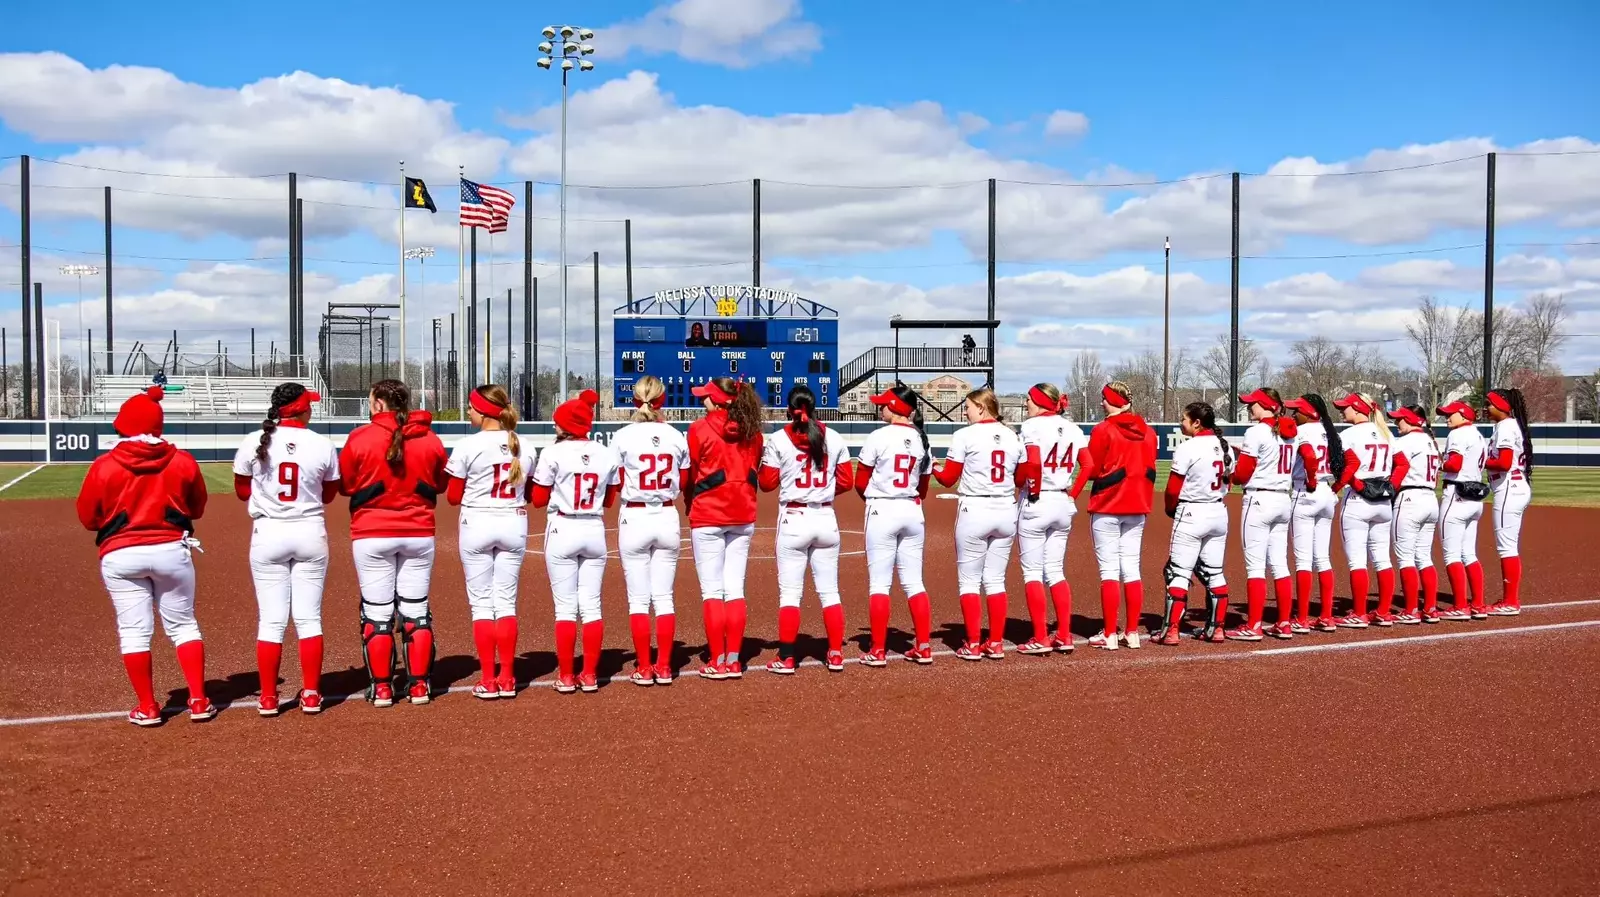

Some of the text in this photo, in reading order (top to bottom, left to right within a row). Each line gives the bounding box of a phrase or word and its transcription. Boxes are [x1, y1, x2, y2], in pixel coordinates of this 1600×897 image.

[655, 284, 798, 305] MELISSA COOK STADIUM
[712, 331, 738, 341] TRAN
[621, 351, 646, 359] AT BAT
[677, 351, 696, 359] BALL
[721, 351, 747, 359] STRIKE
[770, 351, 786, 360] OUT
[812, 351, 826, 360] H/E
[766, 376, 783, 384] RUNS
[793, 376, 808, 384] HITS
[818, 376, 831, 384] ERR
[55, 434, 90, 450] 200
[990, 450, 1005, 483] 8
[1043, 441, 1075, 474] 44
[1277, 444, 1294, 475] 10
[1364, 444, 1389, 472] 77
[490, 462, 516, 499] 12
[638, 453, 673, 491] 22
[1210, 460, 1224, 491] 3
[278, 462, 299, 502] 9
[573, 472, 599, 511] 13
